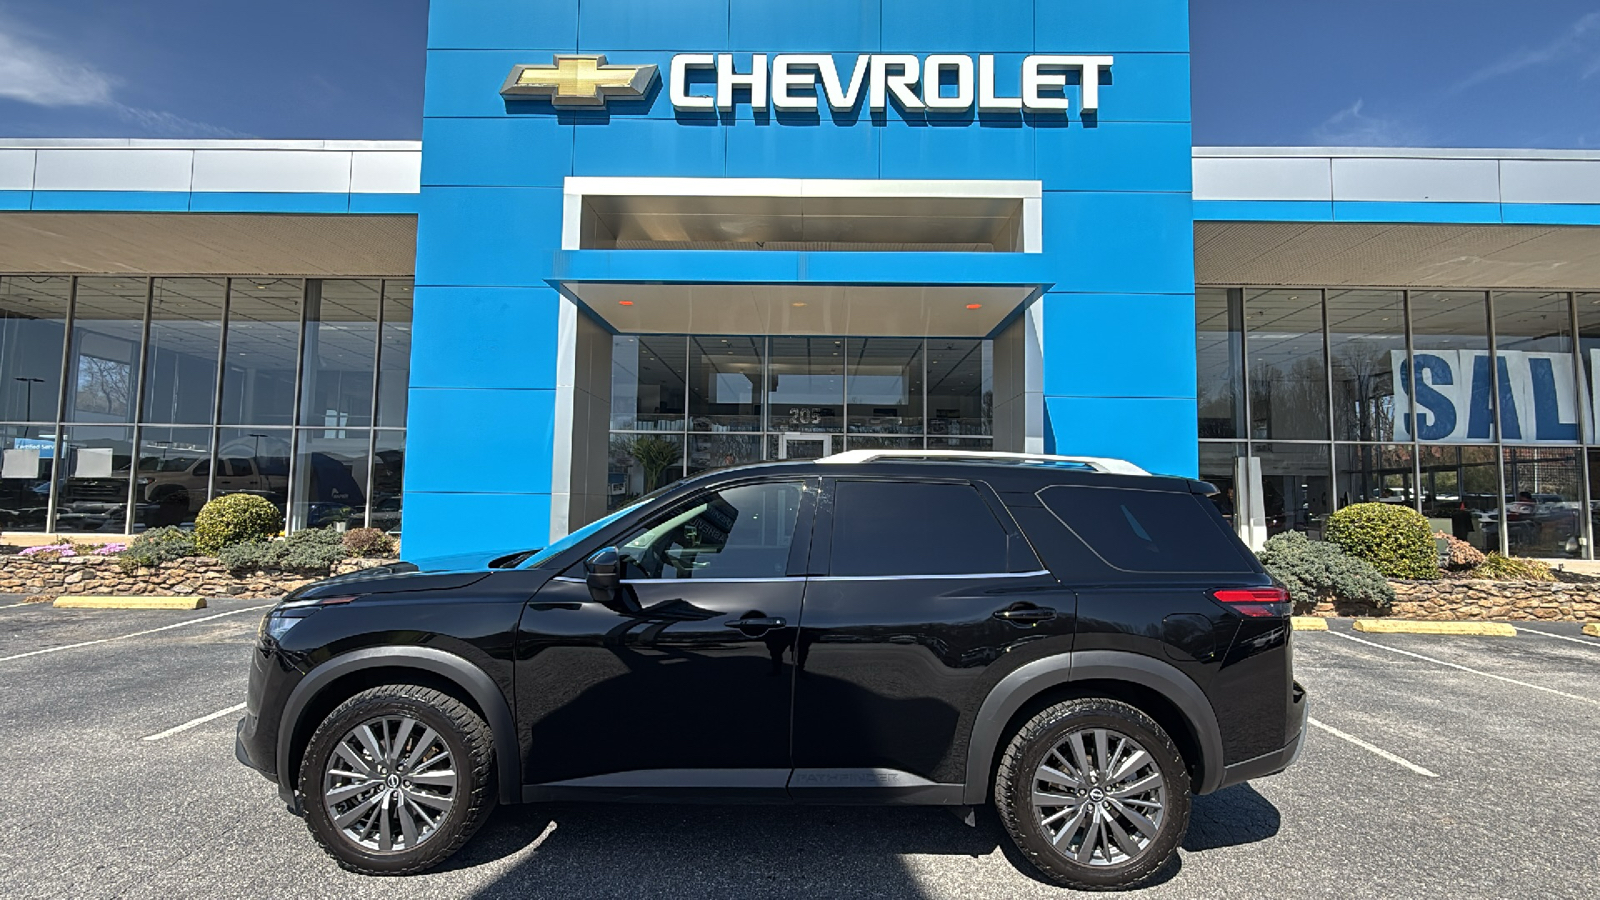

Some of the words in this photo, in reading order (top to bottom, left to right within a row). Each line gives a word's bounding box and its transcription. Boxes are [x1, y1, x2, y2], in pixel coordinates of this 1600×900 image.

[669, 54, 1114, 112] CHEVROLET
[789, 407, 822, 424] 205
[796, 773, 902, 783] PATHFINDER
